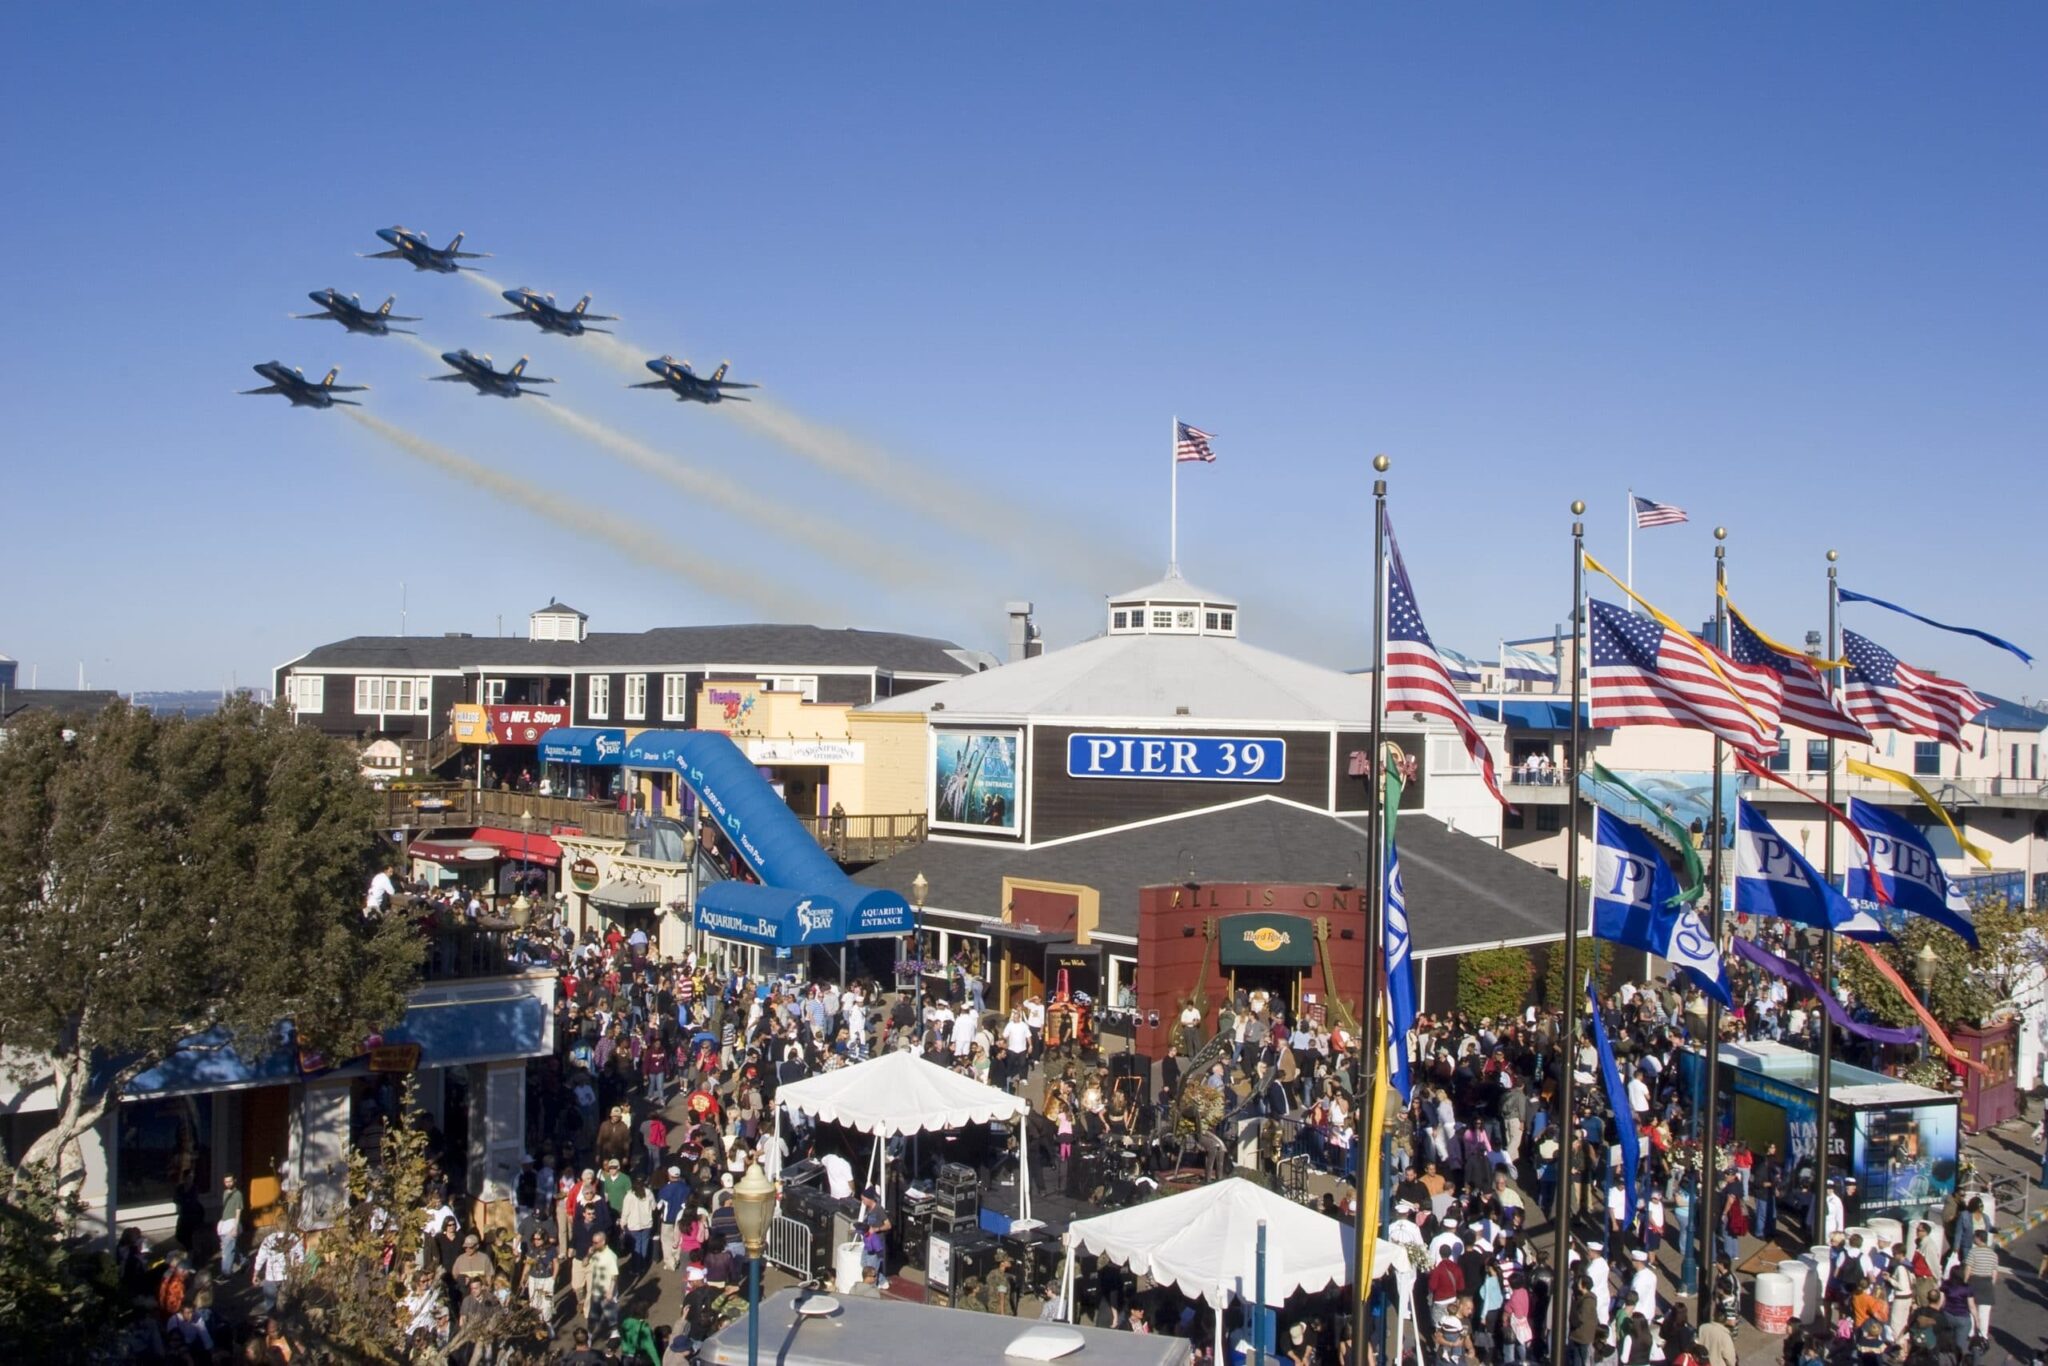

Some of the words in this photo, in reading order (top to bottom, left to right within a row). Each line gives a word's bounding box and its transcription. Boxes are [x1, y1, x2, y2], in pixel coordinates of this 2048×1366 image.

[510, 711, 530, 723] NFL
[533, 711, 561, 725] Shop
[1087, 739, 1201, 774] PIER
[1215, 743, 1265, 775] 39
[985, 780, 1013, 789] ENTRANCE
[713, 800, 726, 817] Fish
[740, 834, 754, 853] Touch
[751, 849, 765, 866] Pool
[1170, 889, 1219, 909] ALL
[1245, 888, 1275, 907] IS
[1303, 890, 1367, 912] ONE
[1860, 900, 1880, 911] BAY
[861, 907, 903, 918] AQUARIUM
[700, 906, 742, 930] AQUARIUM
[758, 918, 778, 939] BAY
[812, 917, 833, 929] BAY
[861, 917, 903, 927] ENTRANCE
[1243, 930, 1267, 942] Hard
[1267, 931, 1291, 945] Rock
